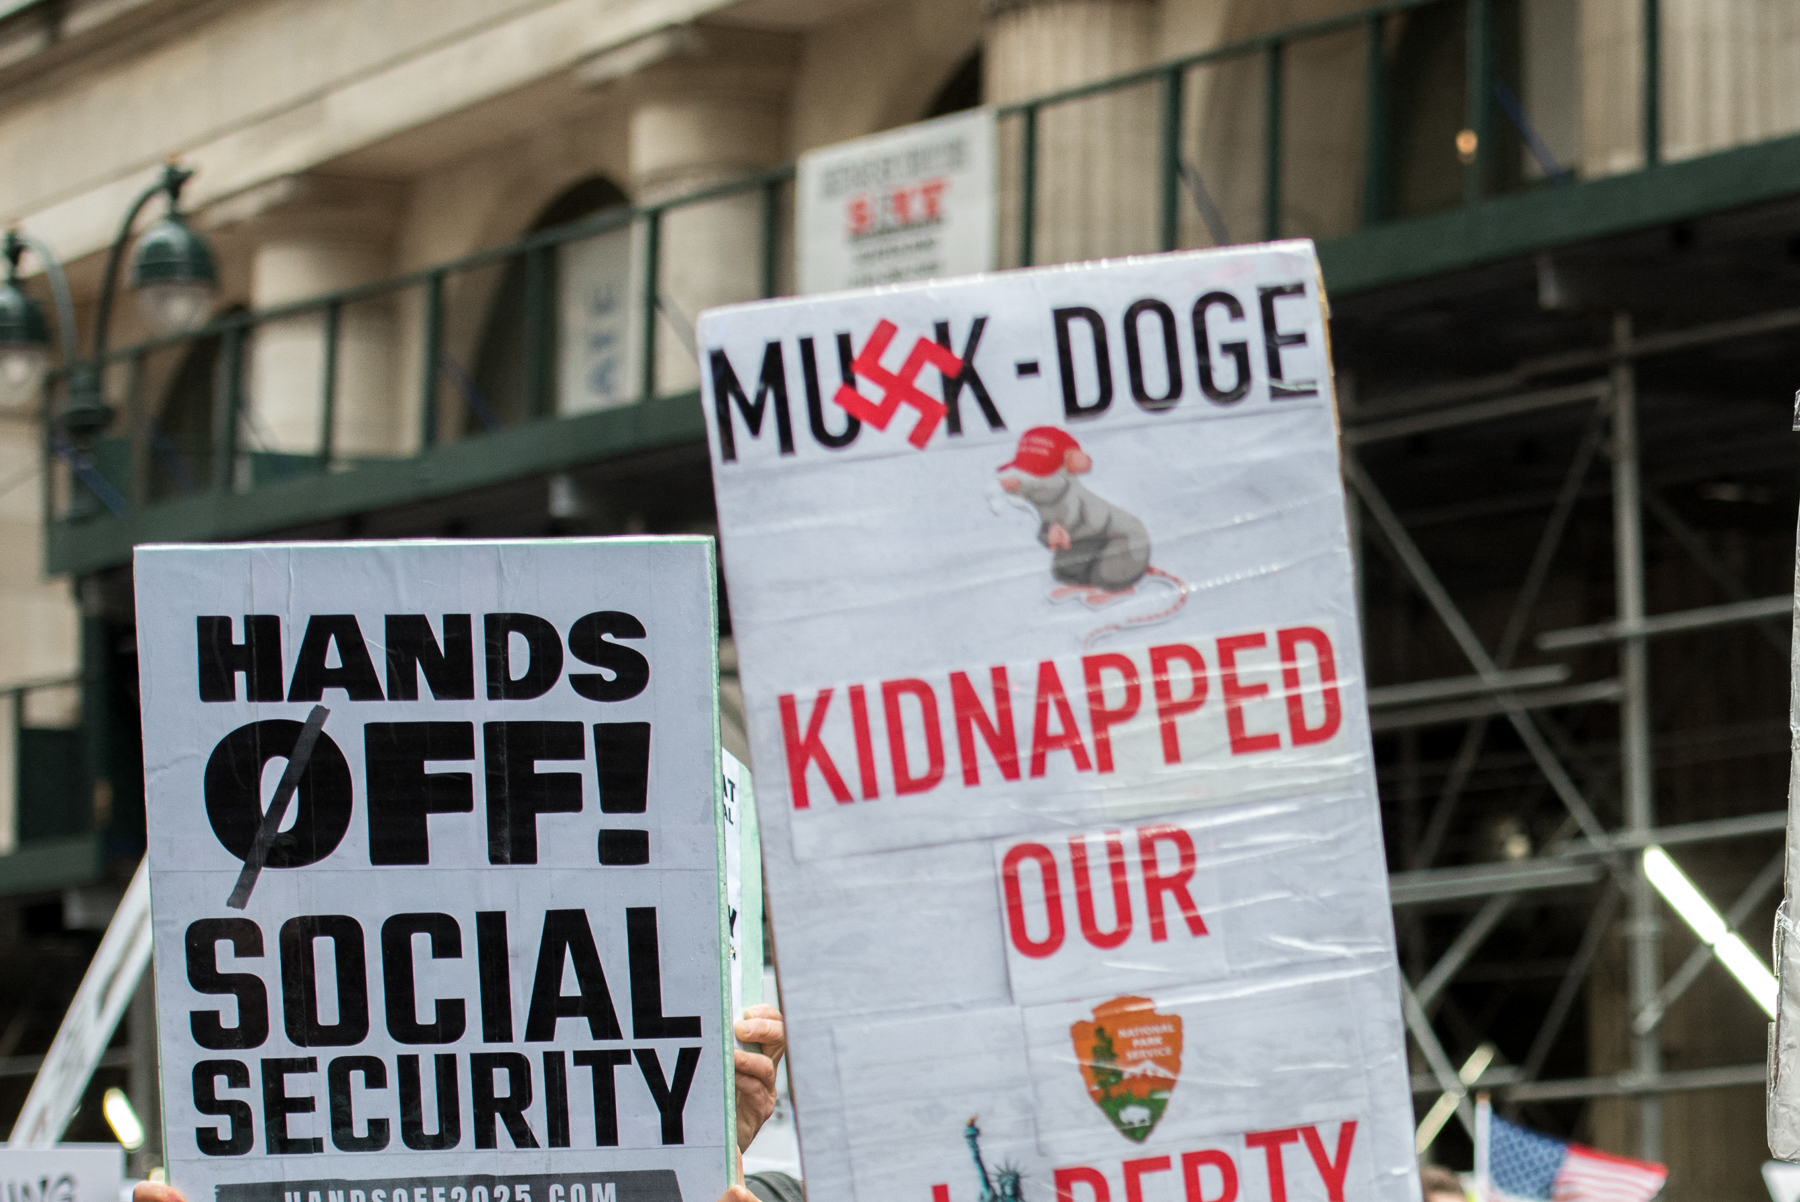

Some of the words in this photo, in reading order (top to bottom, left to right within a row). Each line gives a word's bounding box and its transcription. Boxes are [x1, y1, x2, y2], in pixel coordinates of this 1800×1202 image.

[196, 610, 650, 703] HANDS
[778, 626, 1343, 810] KIDNAPPED
[1002, 825, 1209, 959] OUR
[184, 905, 703, 1050] SOCIAL
[1117, 1023, 1175, 1038] NATIONAL
[1125, 1047, 1173, 1061] SERVICE
[1131, 1036, 1163, 1048] PARK
[191, 1046, 703, 1157] SECURITY
